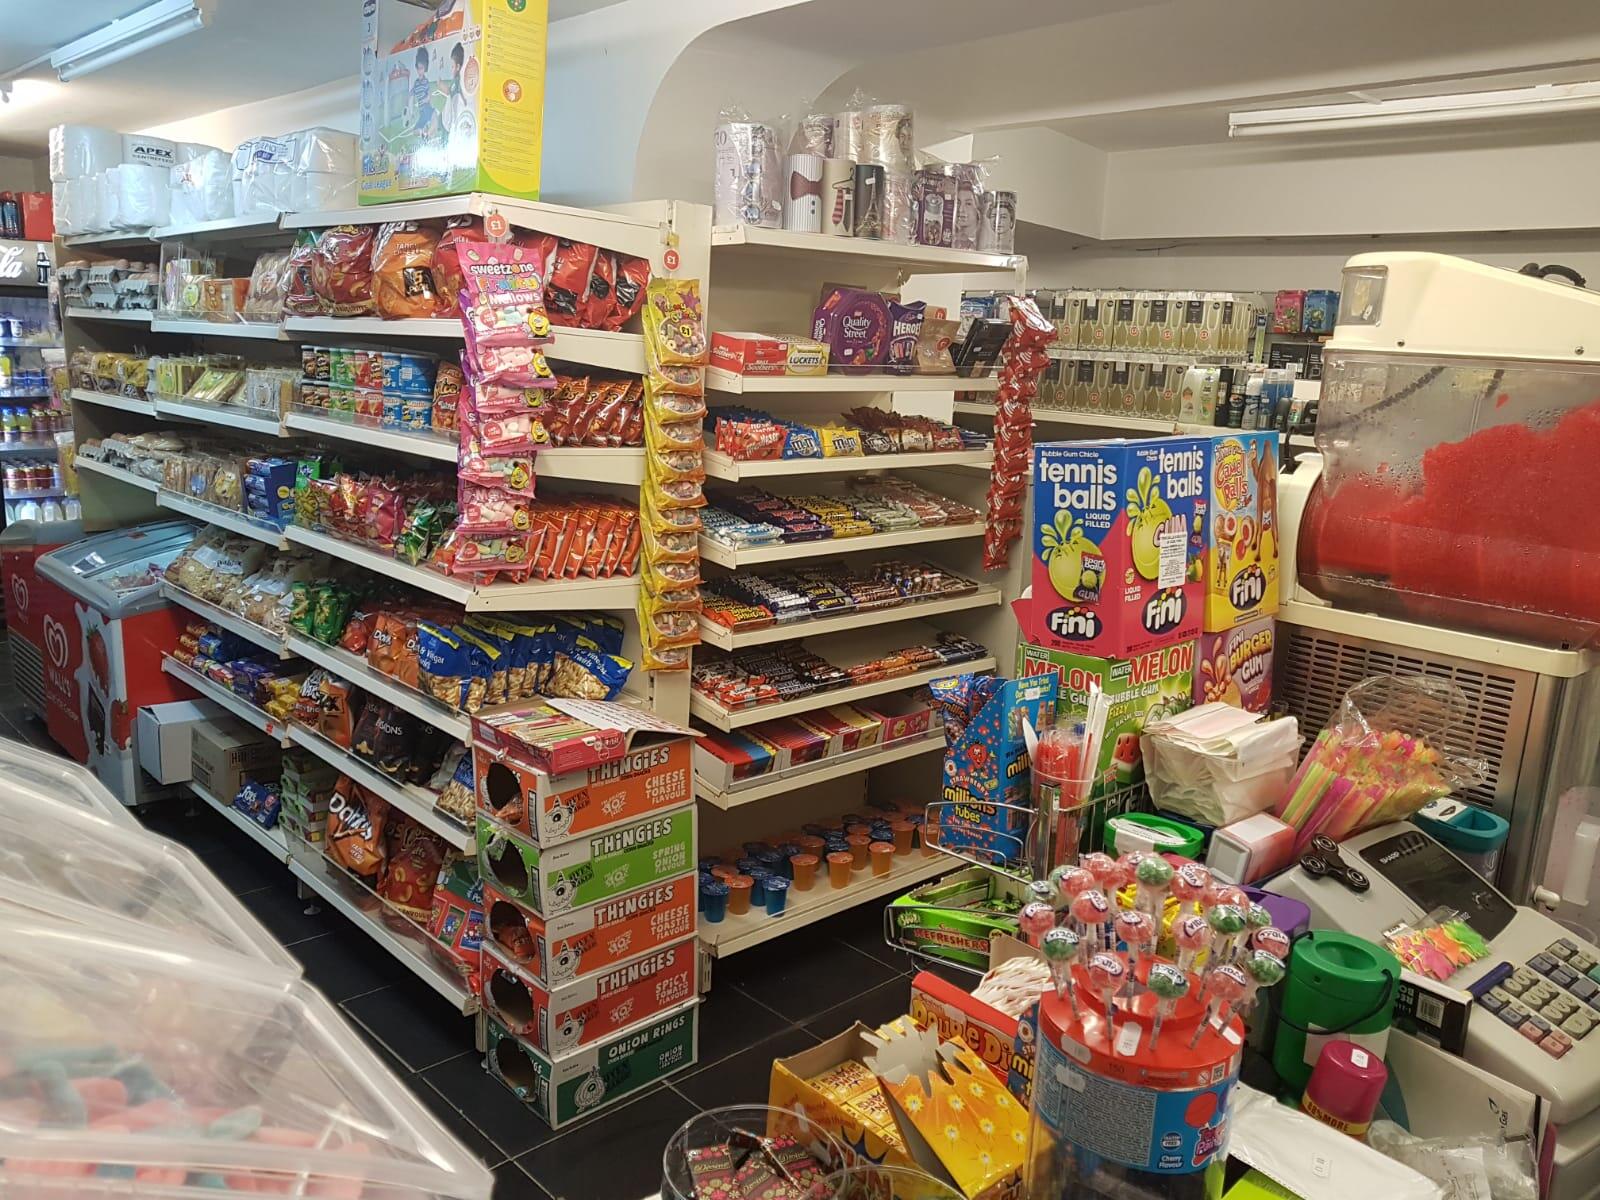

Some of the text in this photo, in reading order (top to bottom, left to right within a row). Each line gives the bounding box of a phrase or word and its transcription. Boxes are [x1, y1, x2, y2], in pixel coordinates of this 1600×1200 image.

[134, 146, 172, 158] APEX
[470, 262, 535, 276] sweetzone
[842, 315, 871, 331] Quality
[844, 327, 867, 338] Street
[892, 320, 922, 337] HEROES
[789, 356, 819, 365] LOCKETS
[1159, 445, 1204, 473] tennis
[1039, 457, 1118, 485] tennis
[1167, 470, 1203, 500] balls
[1053, 483, 1117, 511] balls
[1084, 512, 1111, 521] LIQUID
[1084, 520, 1111, 529] FILLED
[1078, 589, 1099, 602] GUM
[1232, 567, 1262, 607] Fini
[1146, 588, 1182, 630] Fini
[1051, 611, 1095, 638] Fini
[1228, 630, 1245, 656] FINI
[1229, 628, 1272, 671] BURGER
[1025, 649, 1049, 660] WATER
[1111, 662, 1133, 679] WATER
[1127, 645, 1195, 688] MELON
[1241, 654, 1263, 682] GUM
[1141, 683, 1160, 697] GUM
[1109, 704, 1129, 719] FIZZY
[1006, 754, 1033, 779] milli
[645, 768, 686, 789] CHEESE
[652, 789, 686, 805] FLAVOUR
[944, 785, 998, 817] millions
[955, 804, 981, 825] tubes
[652, 841, 686, 860] SPRING
[1379, 851, 1400, 864] SHARP
[650, 904, 690, 926] CHEESE
[656, 924, 690, 941] FLAVOUR
[913, 927, 989, 951] REFRESHERS
[656, 981, 689, 1001] TOMATO
[658, 988, 688, 1005] FLAVOUR
[1108, 1062, 1125, 1074] 150
[1321, 1112, 1350, 1132] MORE
